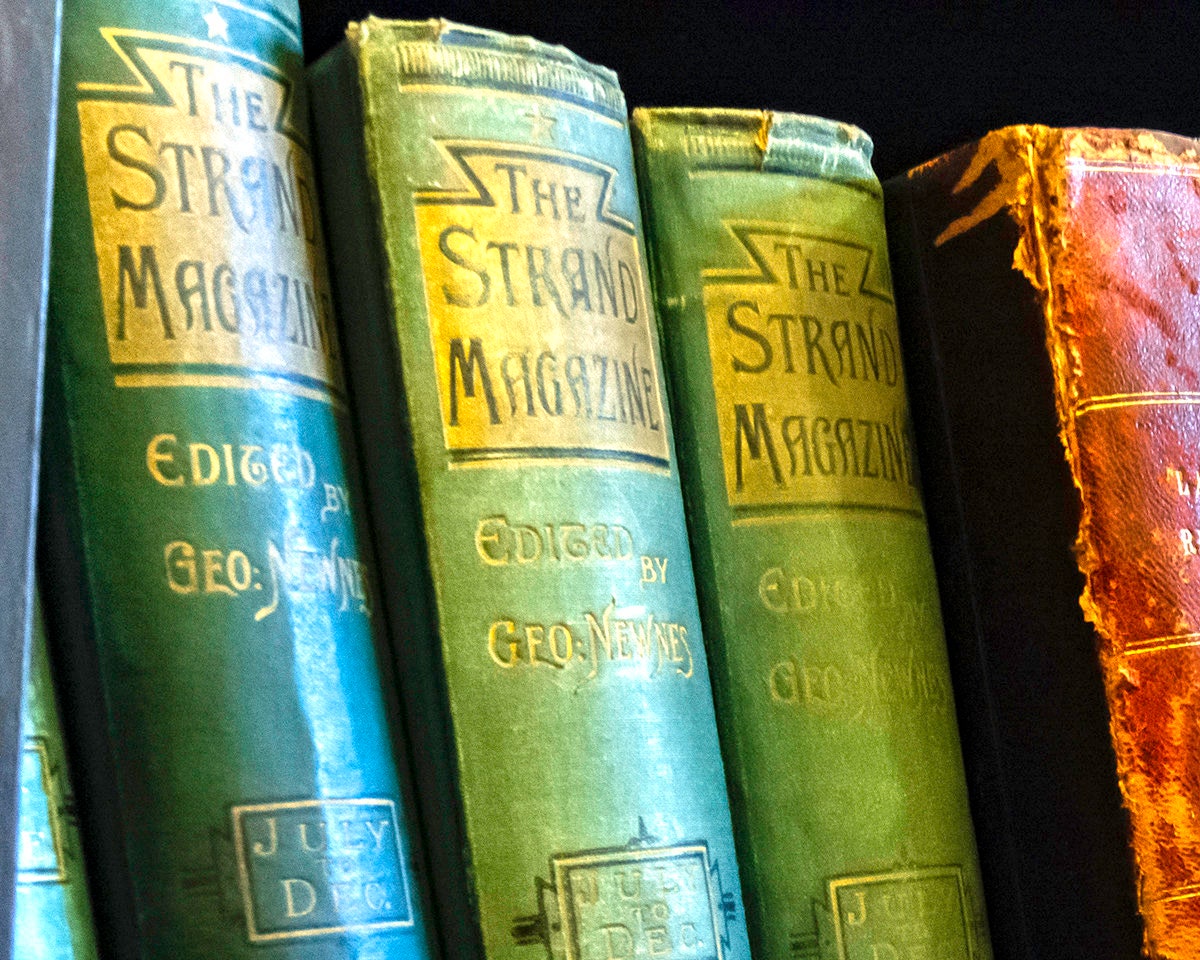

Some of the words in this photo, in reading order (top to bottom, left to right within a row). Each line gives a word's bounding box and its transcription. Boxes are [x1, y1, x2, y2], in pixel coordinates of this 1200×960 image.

[169, 60, 268, 132] THE
[106, 123, 316, 245] STRAND
[495, 163, 586, 222] THE
[438, 225, 639, 325] STRAND
[774, 243, 850, 296] THE
[726, 300, 897, 388] STRAND
[450, 337, 661, 431] MAGAZINE
[146, 433, 315, 489] EDITED
[475, 515, 634, 566] EDITED
[640, 555, 668, 588] BY
[577, 596, 694, 690] NEWNES
[253, 818, 389, 857] JULY
